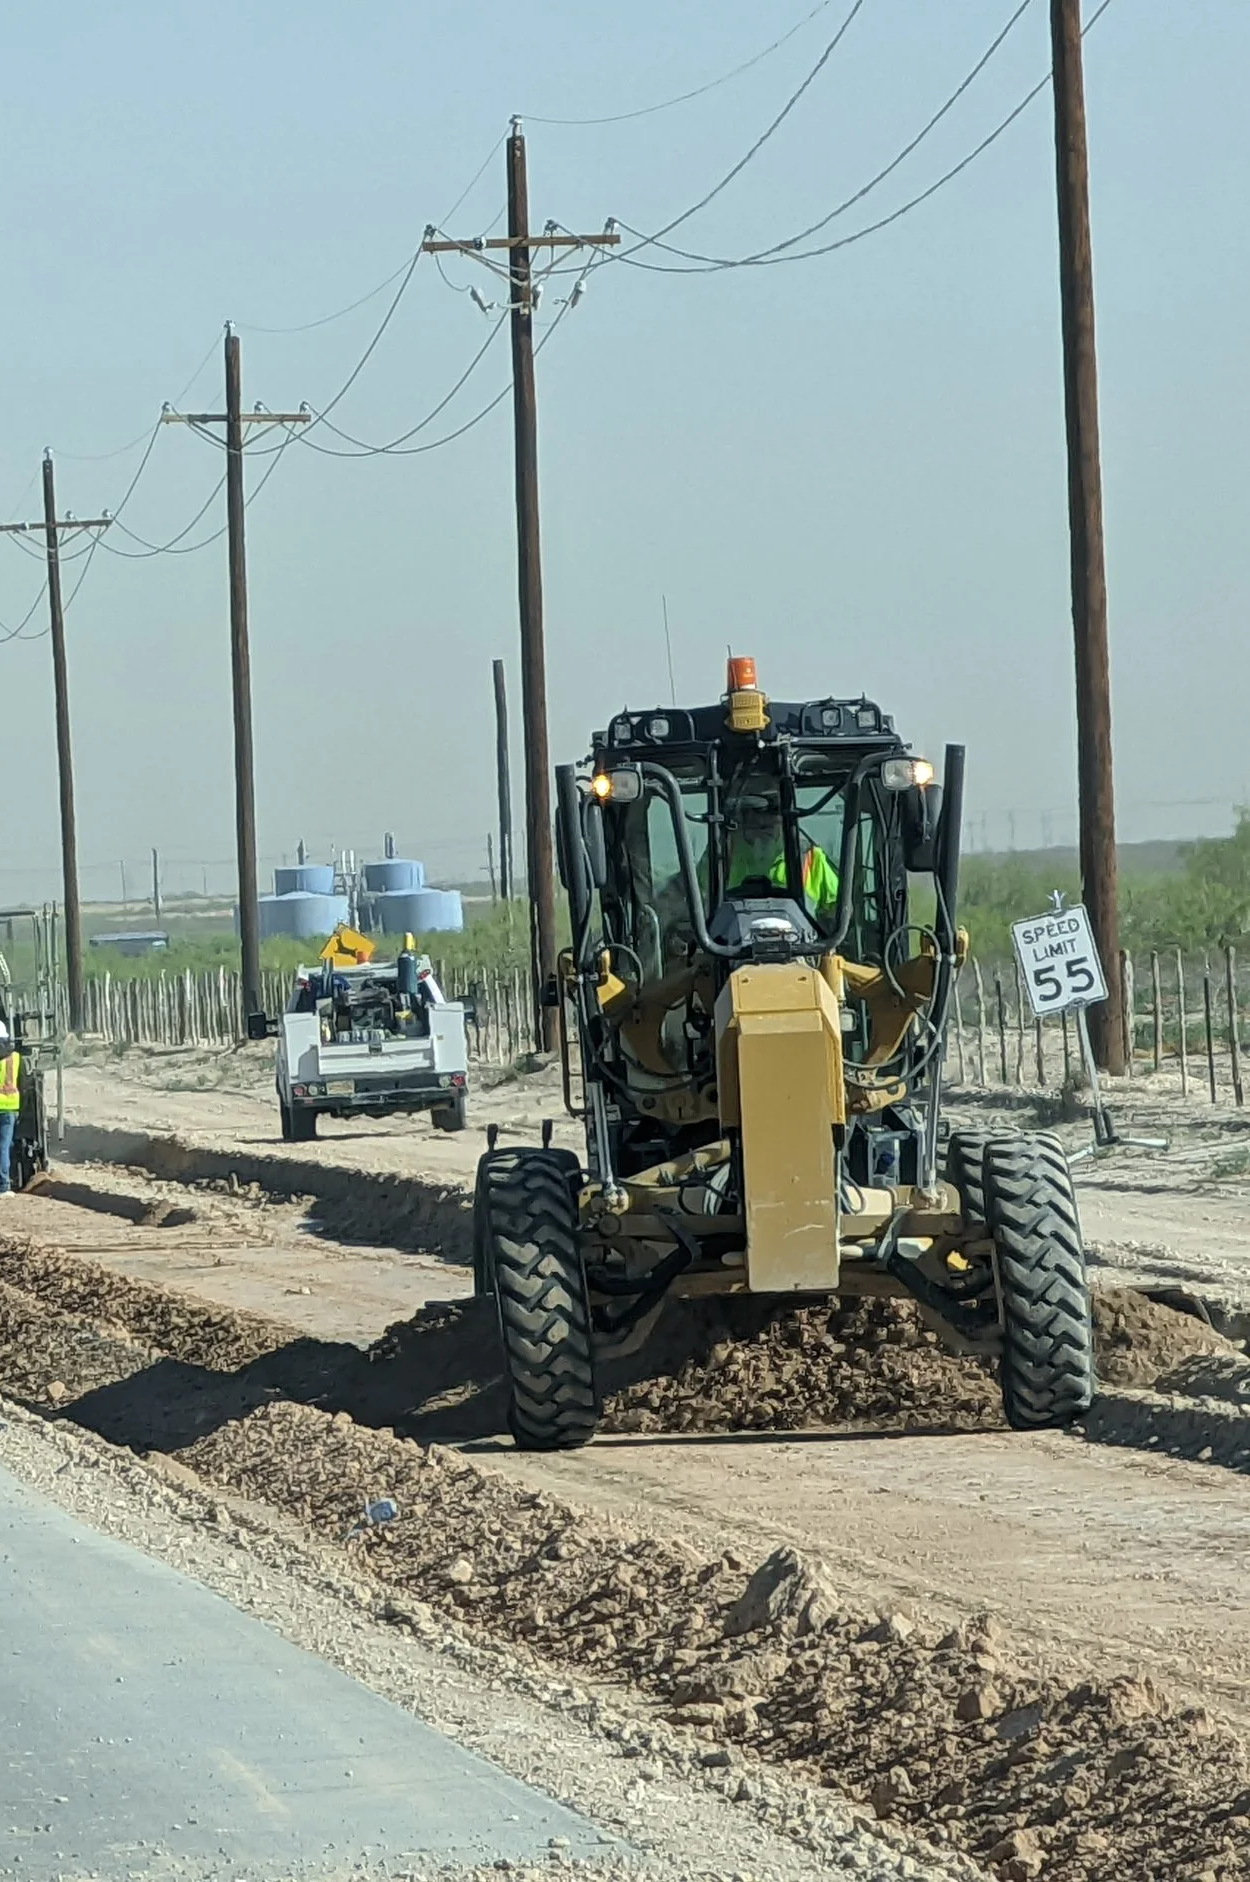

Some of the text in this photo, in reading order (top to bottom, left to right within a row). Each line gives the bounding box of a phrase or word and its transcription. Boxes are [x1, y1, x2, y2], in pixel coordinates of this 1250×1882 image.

[1022, 918, 1080, 944] SPEED
[1032, 938, 1077, 962] LIMIT
[1033, 956, 1095, 1002] 55
